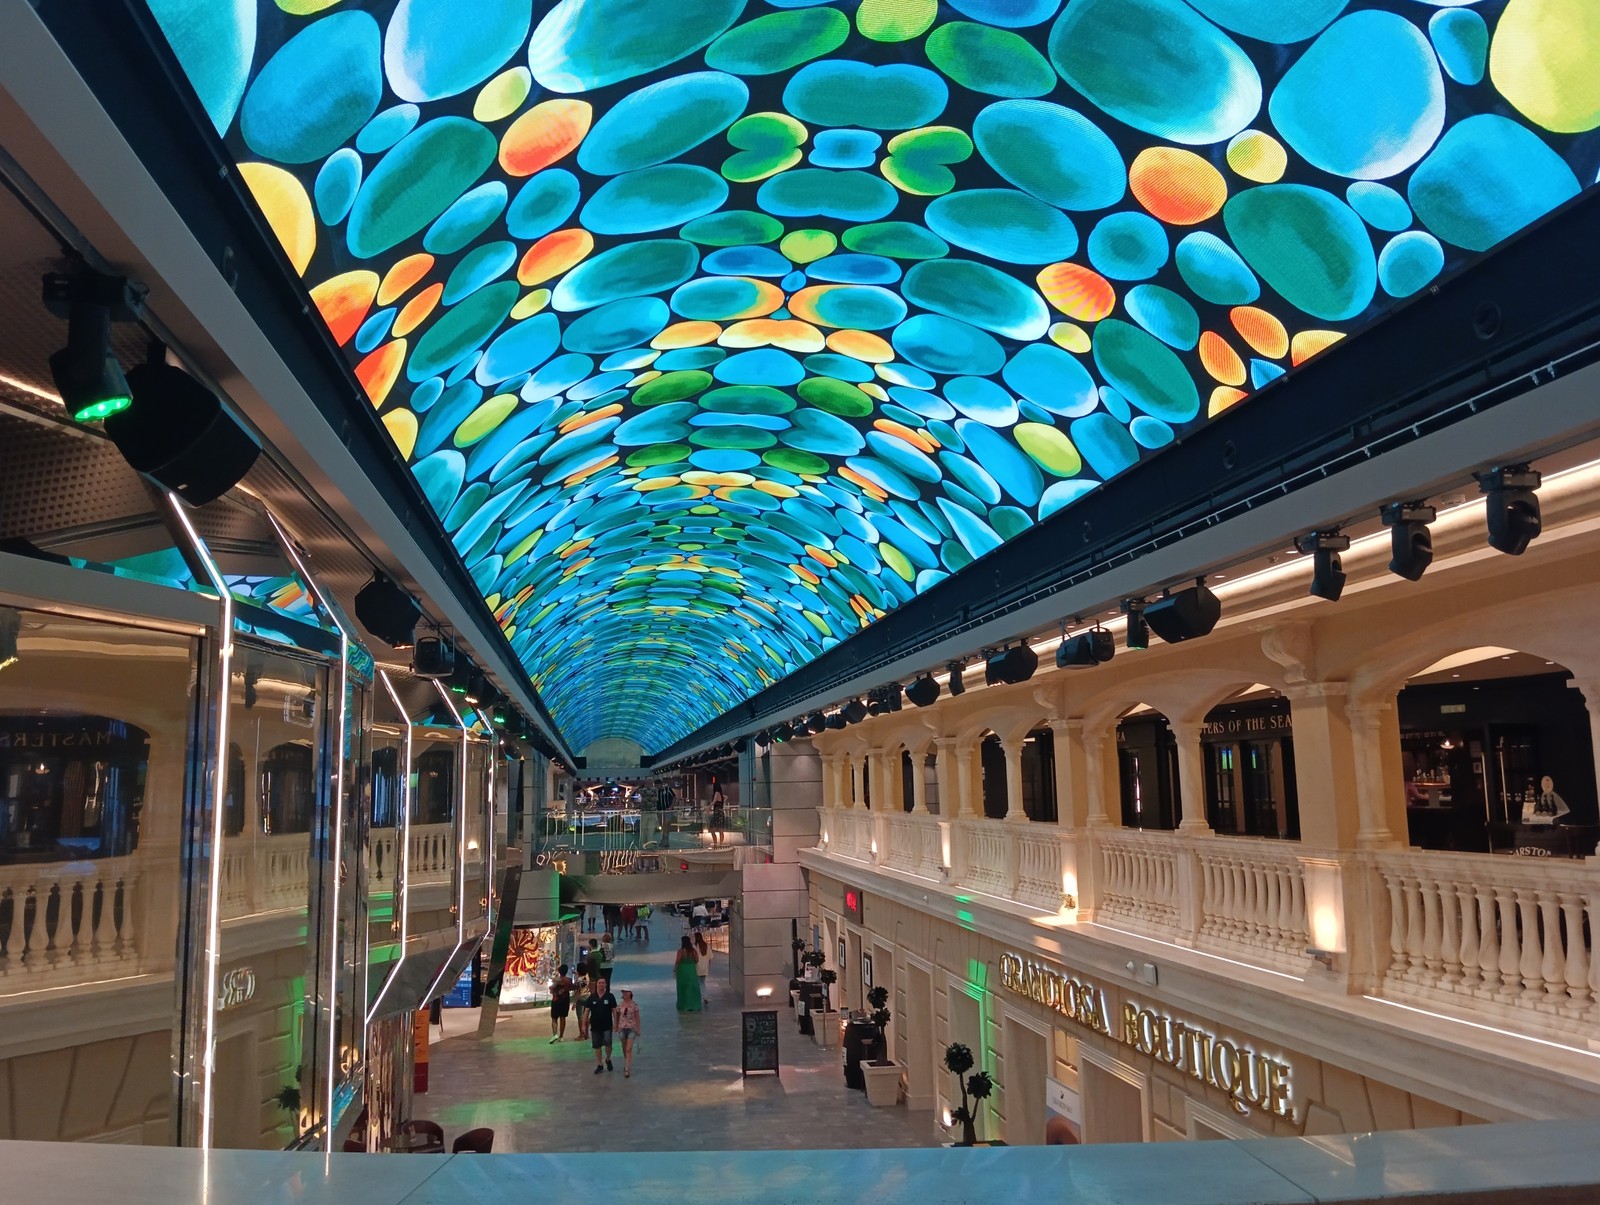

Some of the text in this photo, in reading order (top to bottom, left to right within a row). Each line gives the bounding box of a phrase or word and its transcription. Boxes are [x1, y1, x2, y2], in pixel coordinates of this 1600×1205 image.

[1228, 720, 1242, 732] OF
[1246, 717, 1266, 731] THE
[1270, 714, 1292, 729] SEA
[999, 952, 1298, 1123] GRANDIOSA BOUTIQUE
